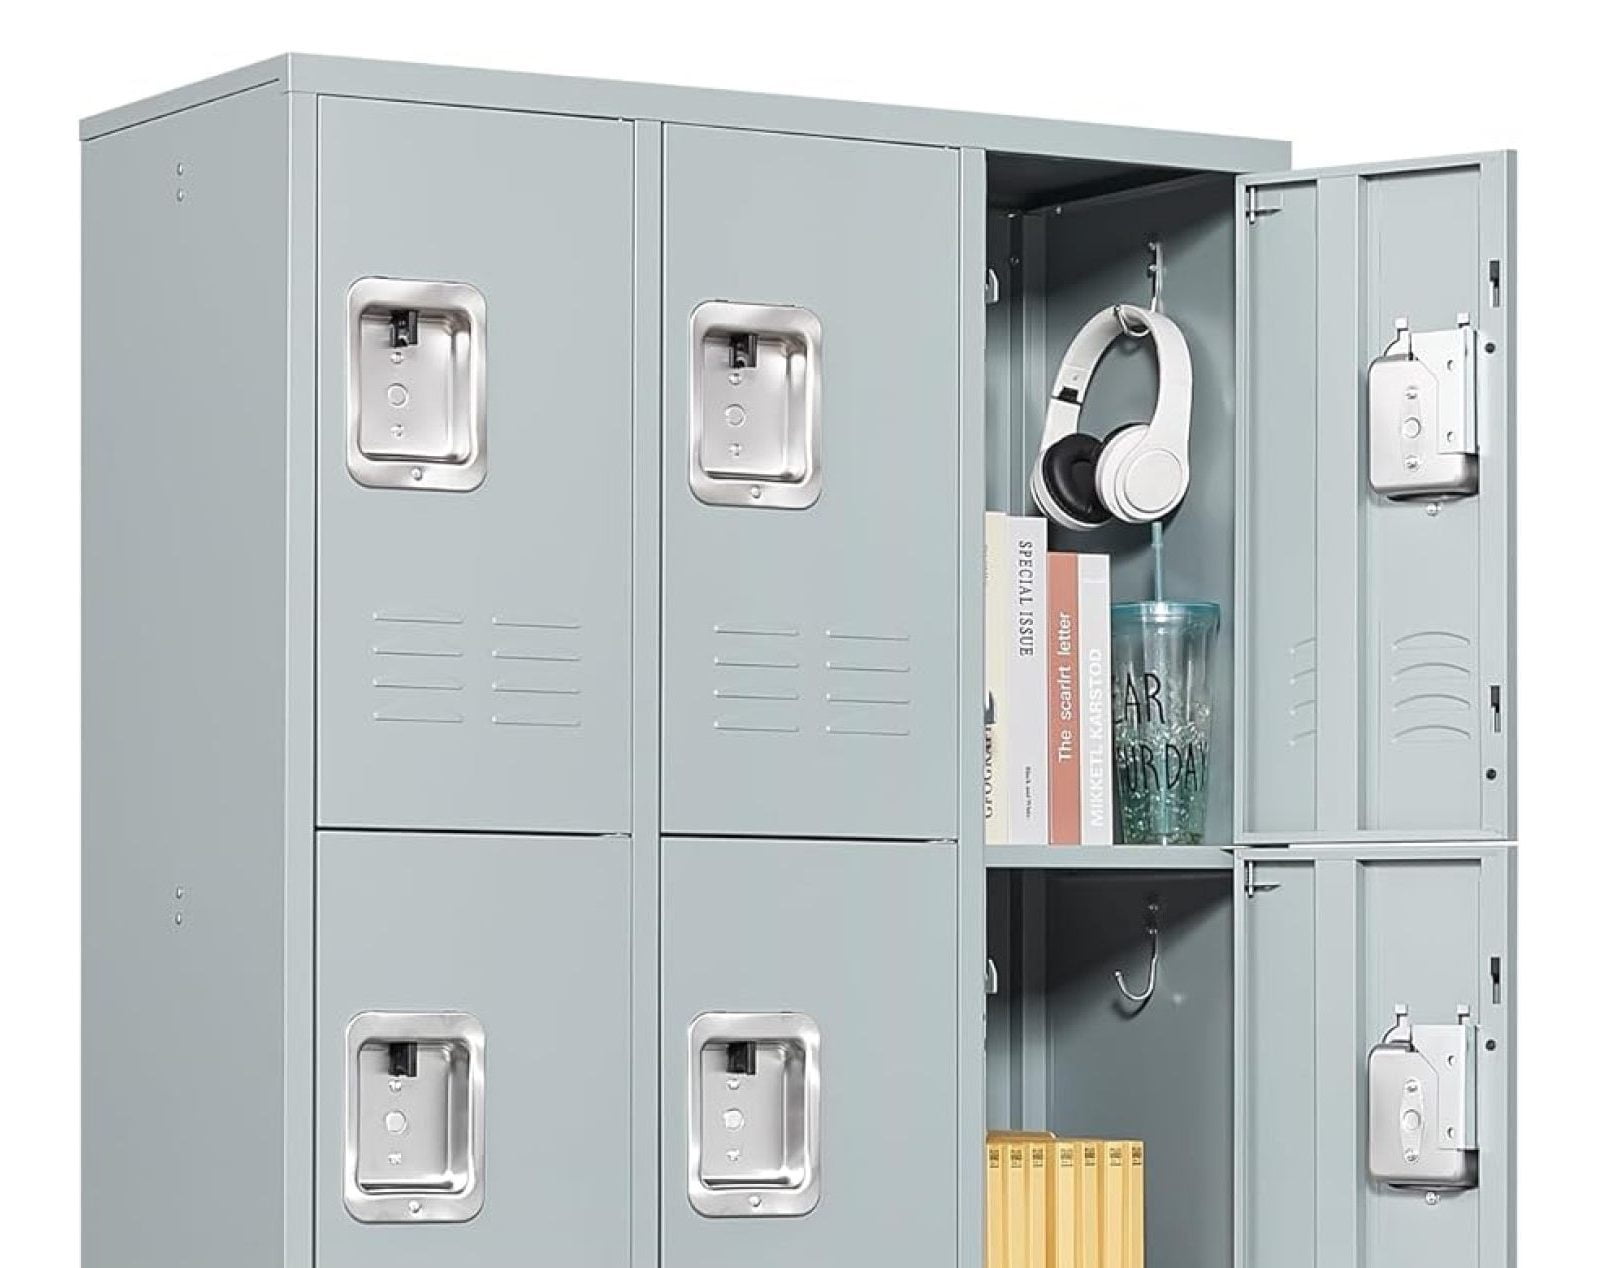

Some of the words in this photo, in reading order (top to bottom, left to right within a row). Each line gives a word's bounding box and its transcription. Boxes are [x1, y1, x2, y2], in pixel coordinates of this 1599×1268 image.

[1019, 540, 1033, 605] SPECIAL
[1019, 611, 1034, 657] ISSUE
[1056, 611, 1071, 656] letter
[1089, 648, 1103, 740] KARSTOD
[1058, 729, 1072, 764] The
